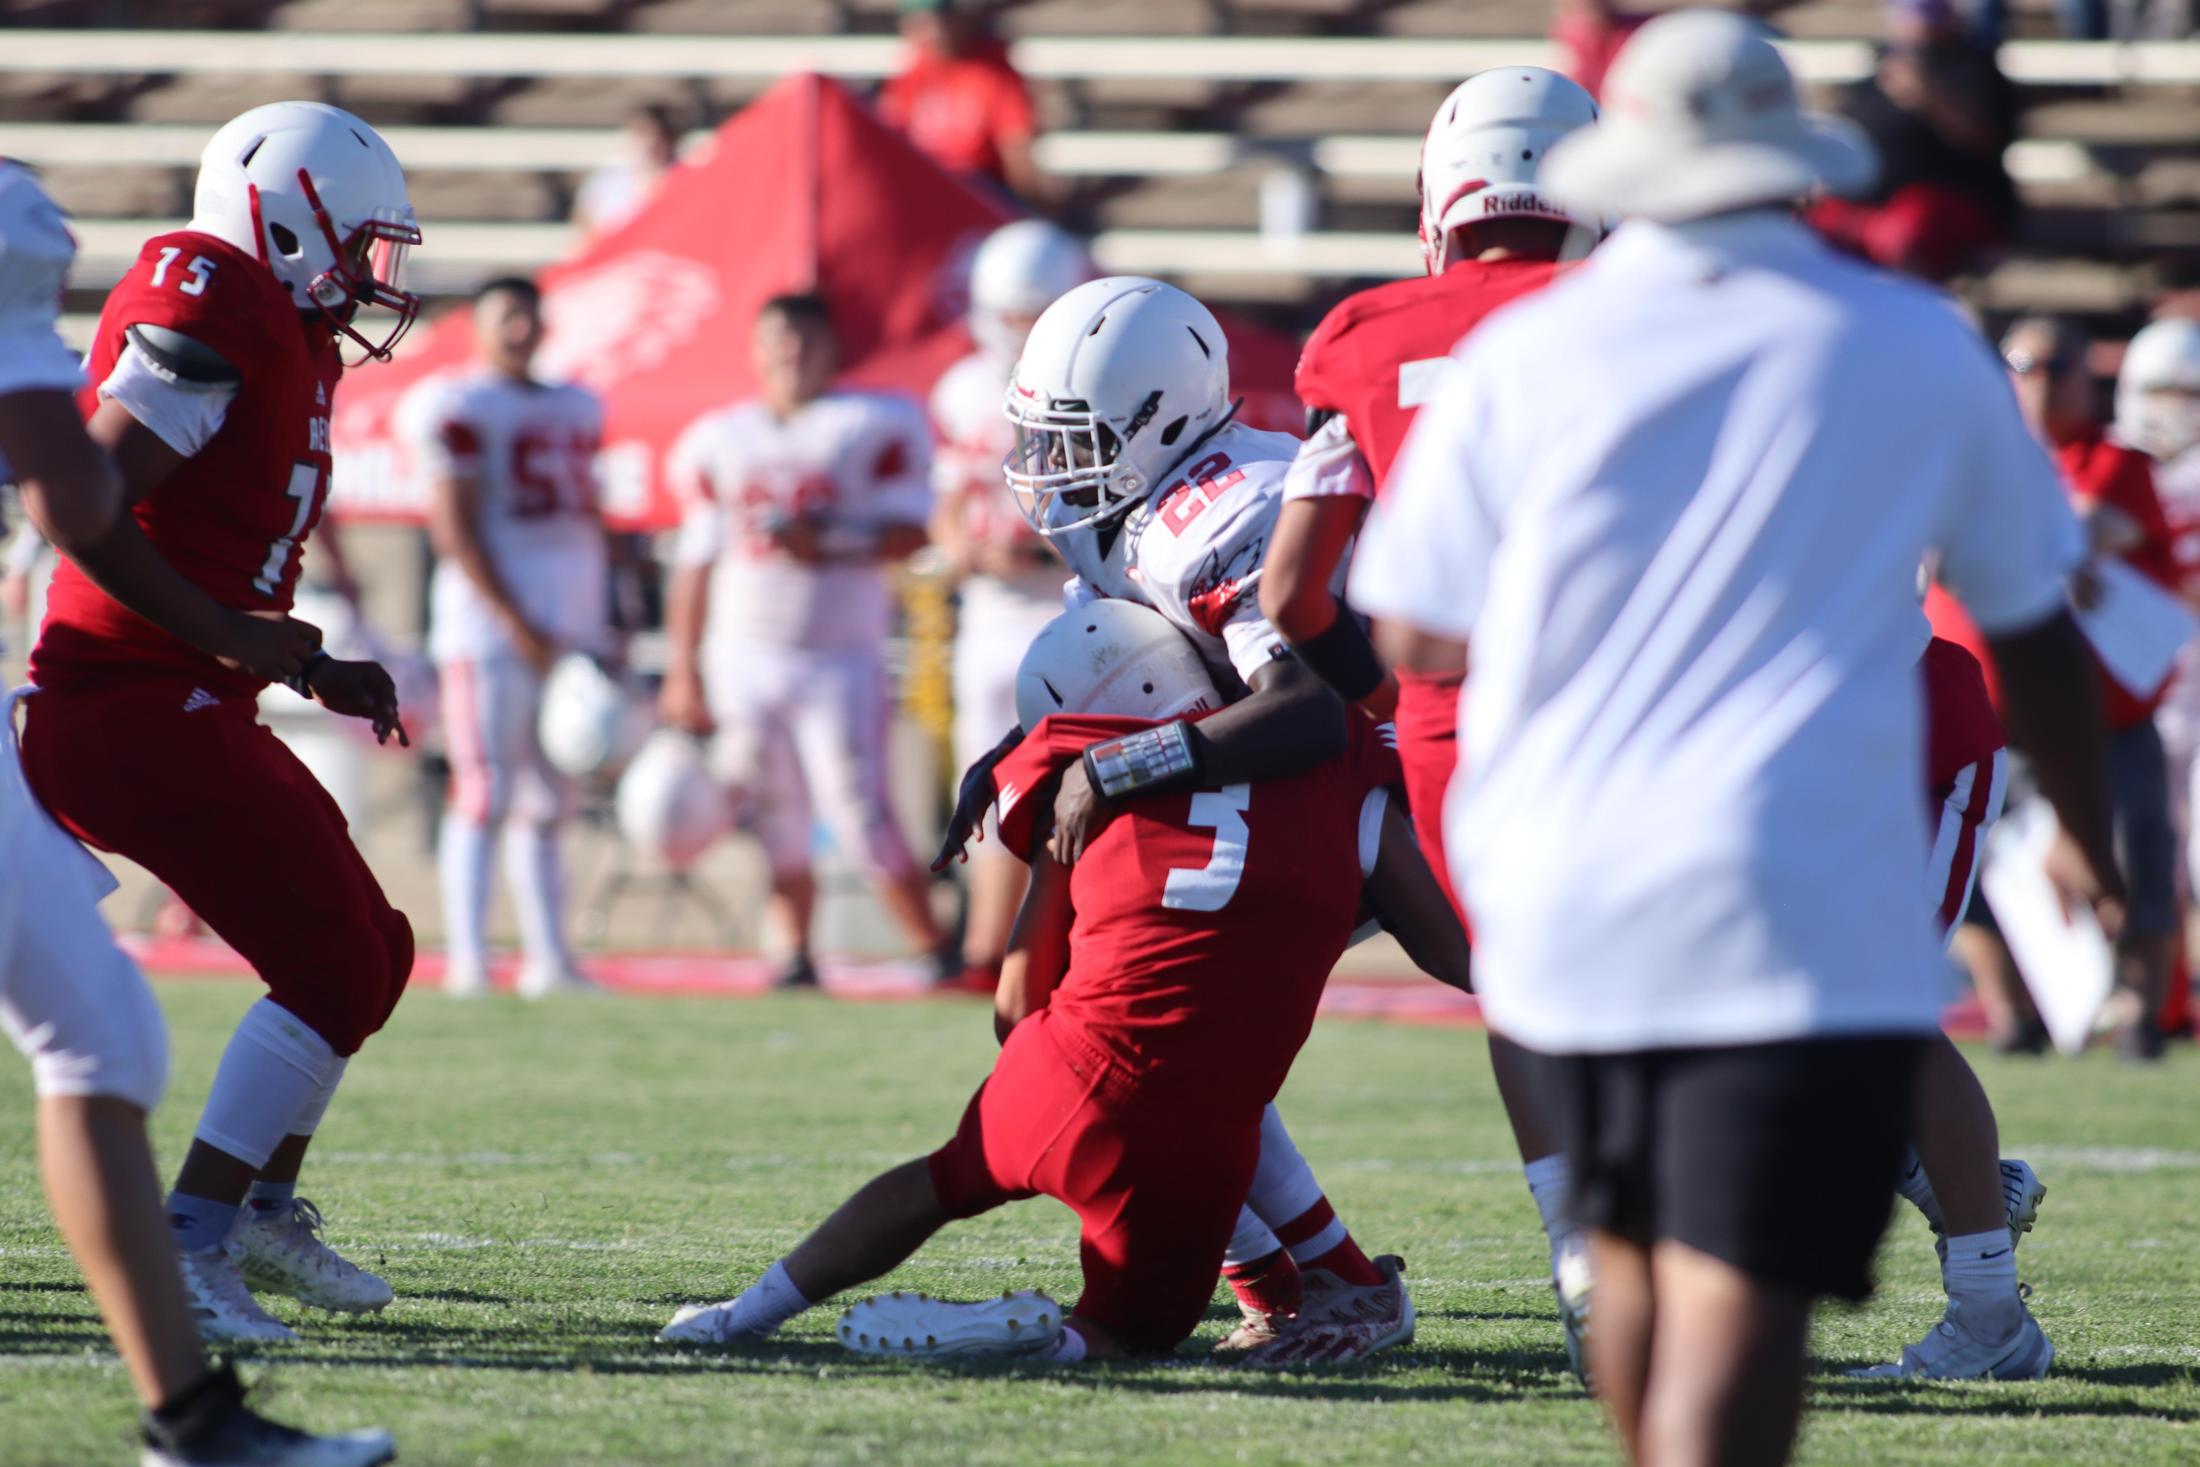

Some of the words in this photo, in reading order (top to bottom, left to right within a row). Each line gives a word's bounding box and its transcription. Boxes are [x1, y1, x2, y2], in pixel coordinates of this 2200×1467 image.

[1483, 192, 1566, 216] Ridde
[149, 245, 217, 297] 75
[252, 462, 326, 596] 7
[1155, 450, 1246, 538] 22
[1160, 781, 1251, 913] 3
